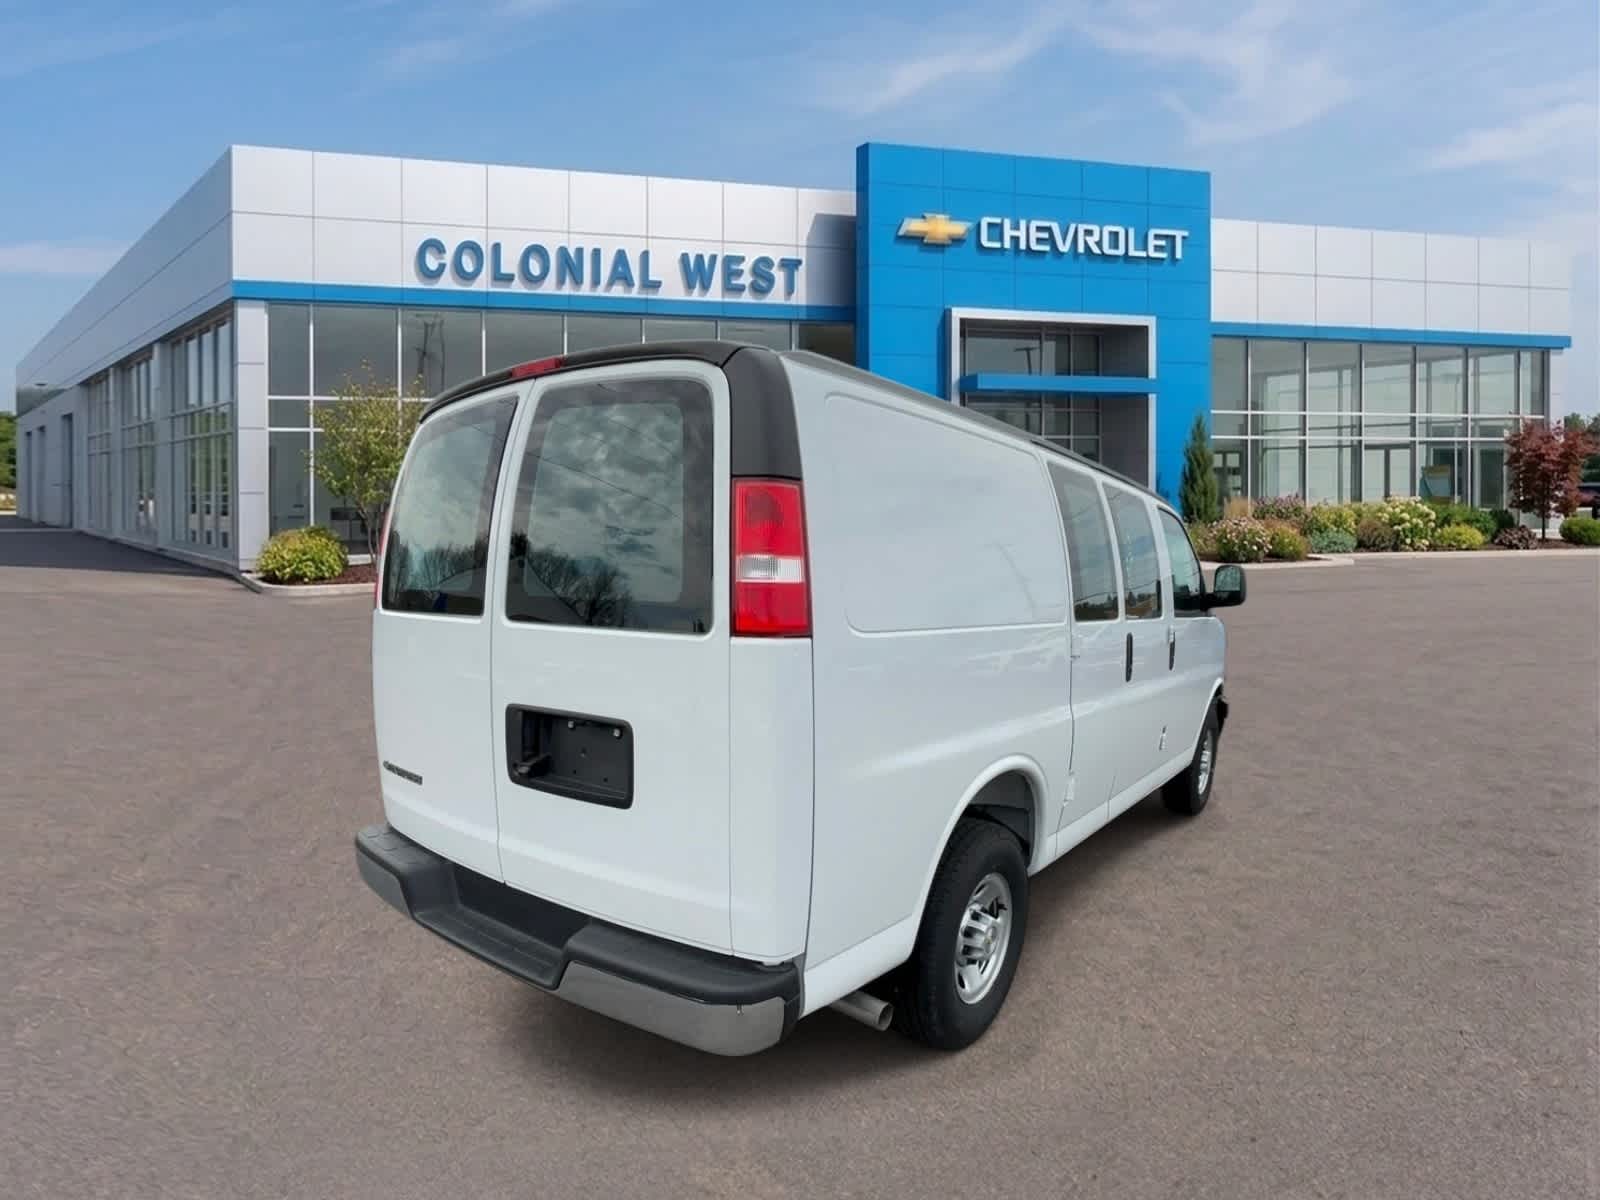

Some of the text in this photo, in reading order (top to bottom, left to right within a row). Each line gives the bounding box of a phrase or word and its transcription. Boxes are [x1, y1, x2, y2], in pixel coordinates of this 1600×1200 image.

[979, 216, 1189, 261] CHEVROLET
[415, 238, 803, 297] COLONIAL WEST
